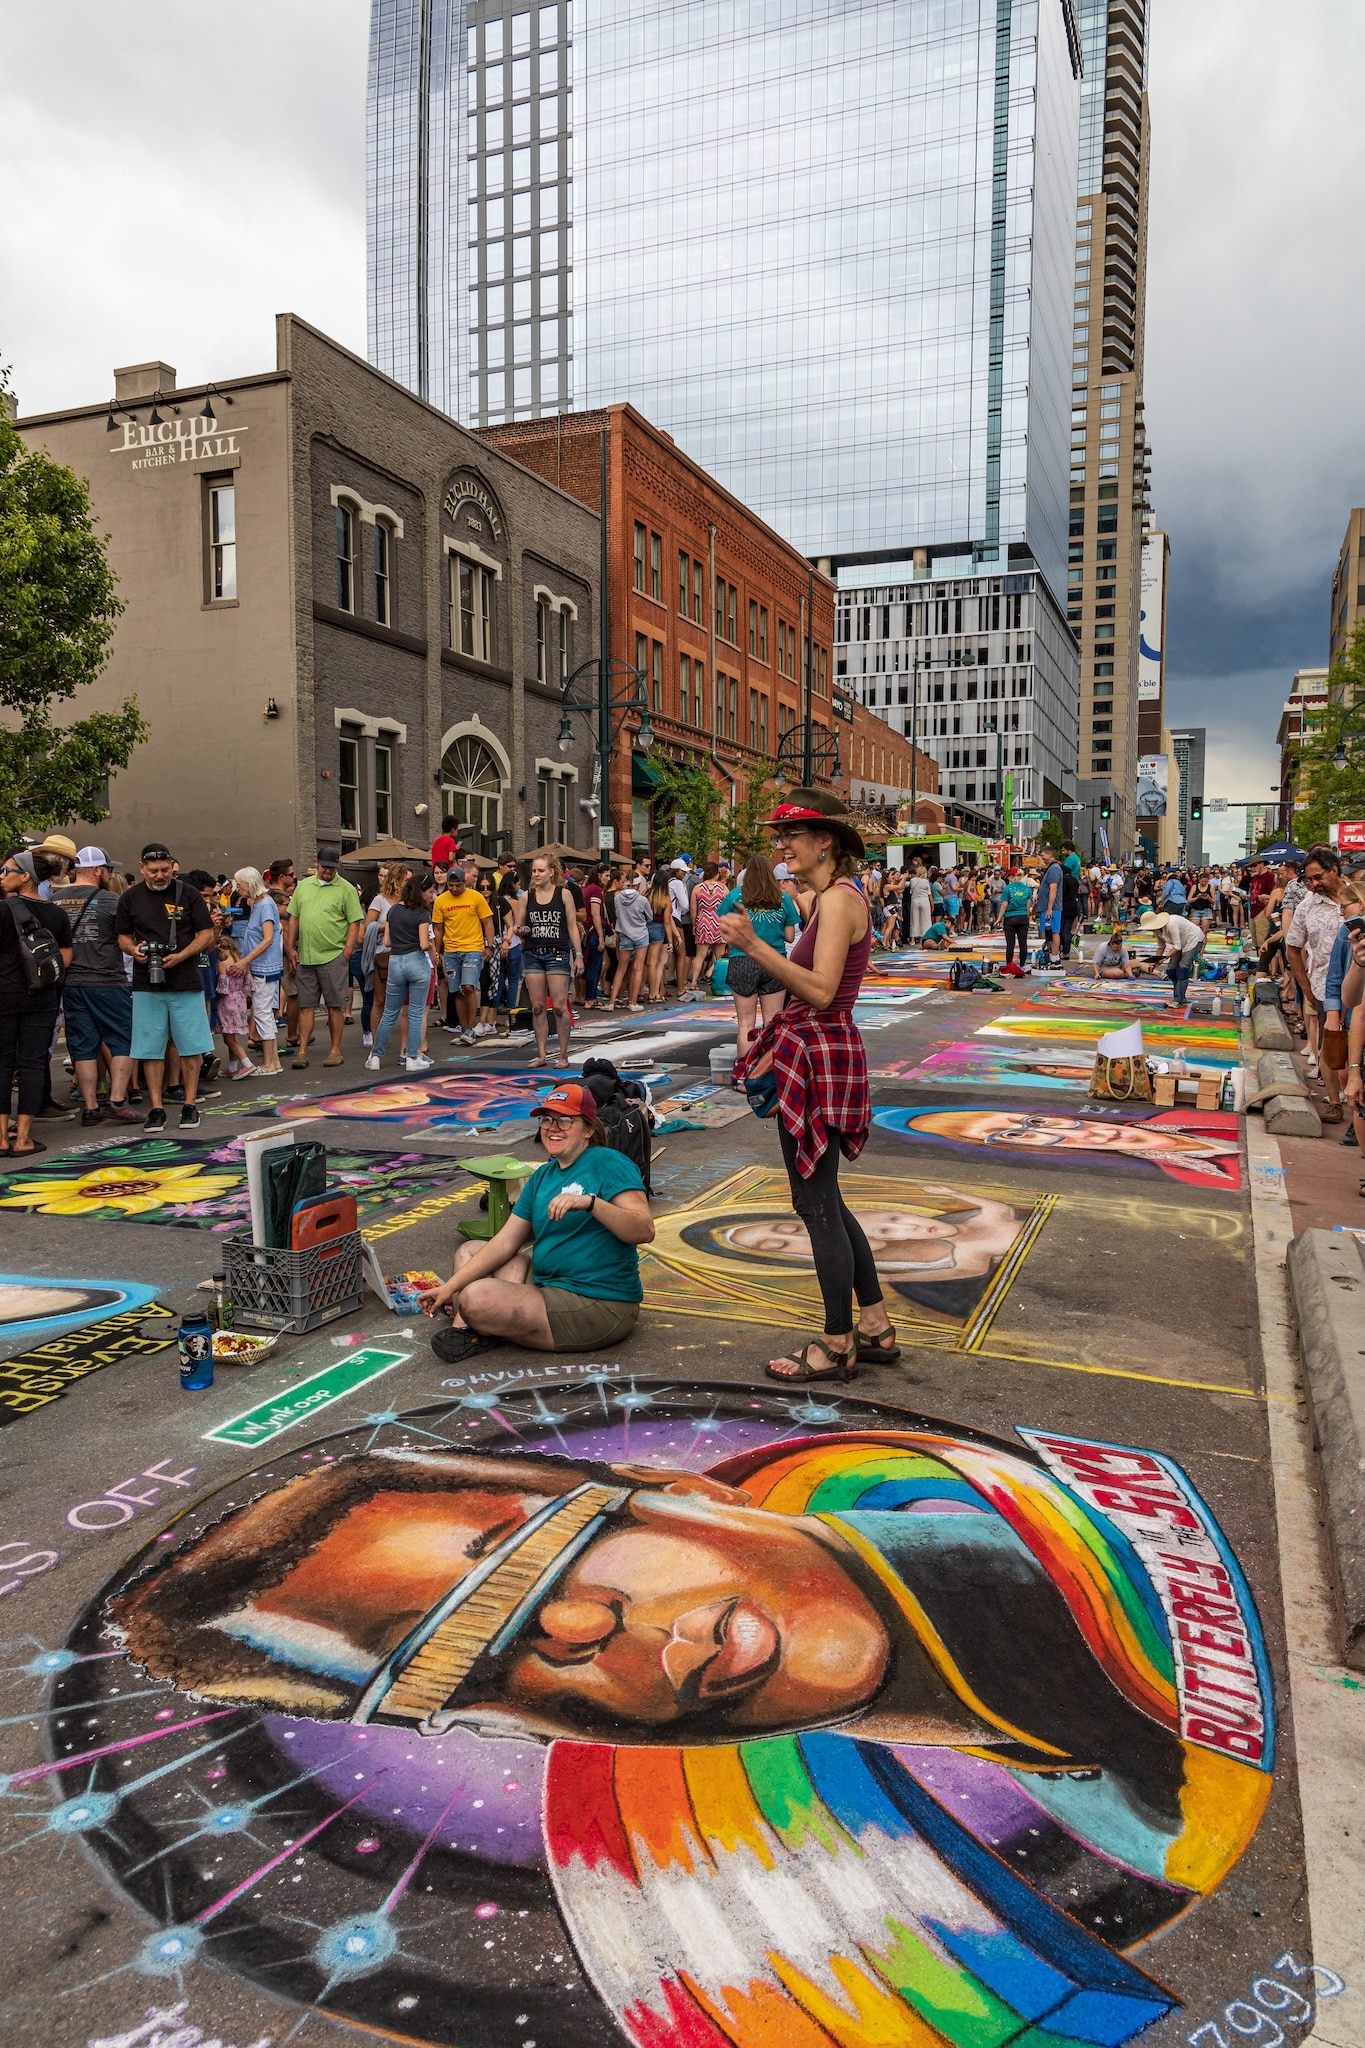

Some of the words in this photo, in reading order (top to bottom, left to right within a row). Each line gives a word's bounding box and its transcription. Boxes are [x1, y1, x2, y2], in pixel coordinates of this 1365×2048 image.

[131, 455, 176, 469] KITCHEN
[145, 446, 165, 458] BAR
[168, 444, 176, 453] &
[179, 436, 240, 462] HALL
[443, 481, 478, 517] EUCLID
[479, 490, 501, 542] HALL
[1021, 811, 1041, 819] Larimer
[529, 911, 561, 923] RELEASE
[19, 1301, 174, 1362] Animal
[20, 1335, 178, 1392] Evans
[441, 1363, 620, 1387] @KVULETICH
[226, 1388, 333, 1438] Wynkoop
[66, 1458, 198, 1530] OFF
[1034, 1436, 1200, 1530] SKY
[1170, 1525, 1204, 1547] THE
[1156, 1551, 1263, 1760] BUTTERFLY
[1187, 1951, 1346, 2048] 7993
